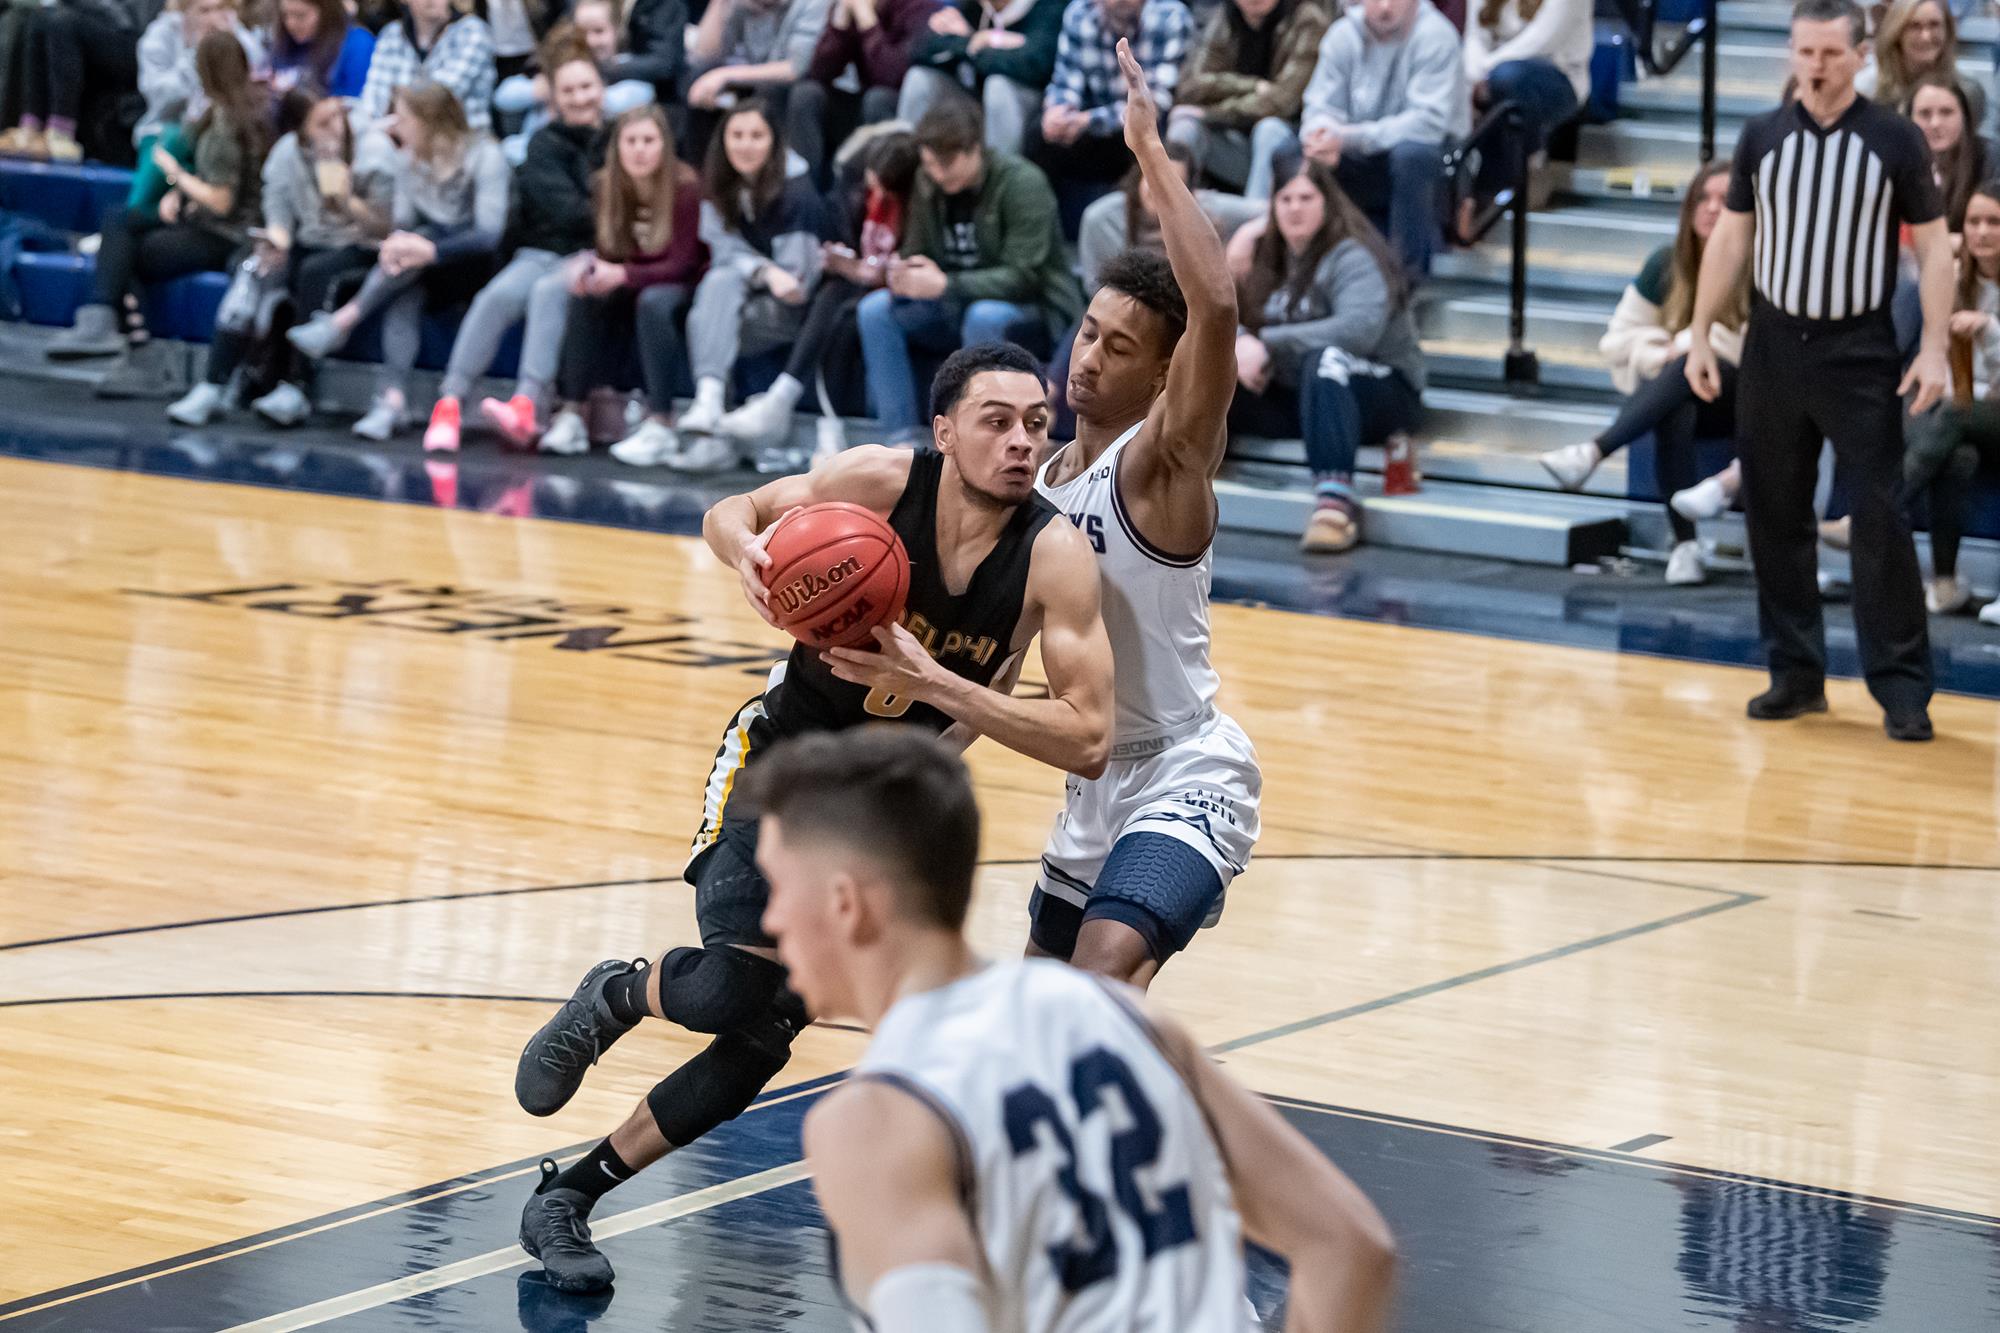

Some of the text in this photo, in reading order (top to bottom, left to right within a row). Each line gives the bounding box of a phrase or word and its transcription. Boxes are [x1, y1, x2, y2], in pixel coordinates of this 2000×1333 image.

[776, 554, 866, 616] Wilson
[810, 597, 876, 641] NCAA
[900, 607, 999, 668] ELPHI
[1002, 1044, 1198, 1293] 32
